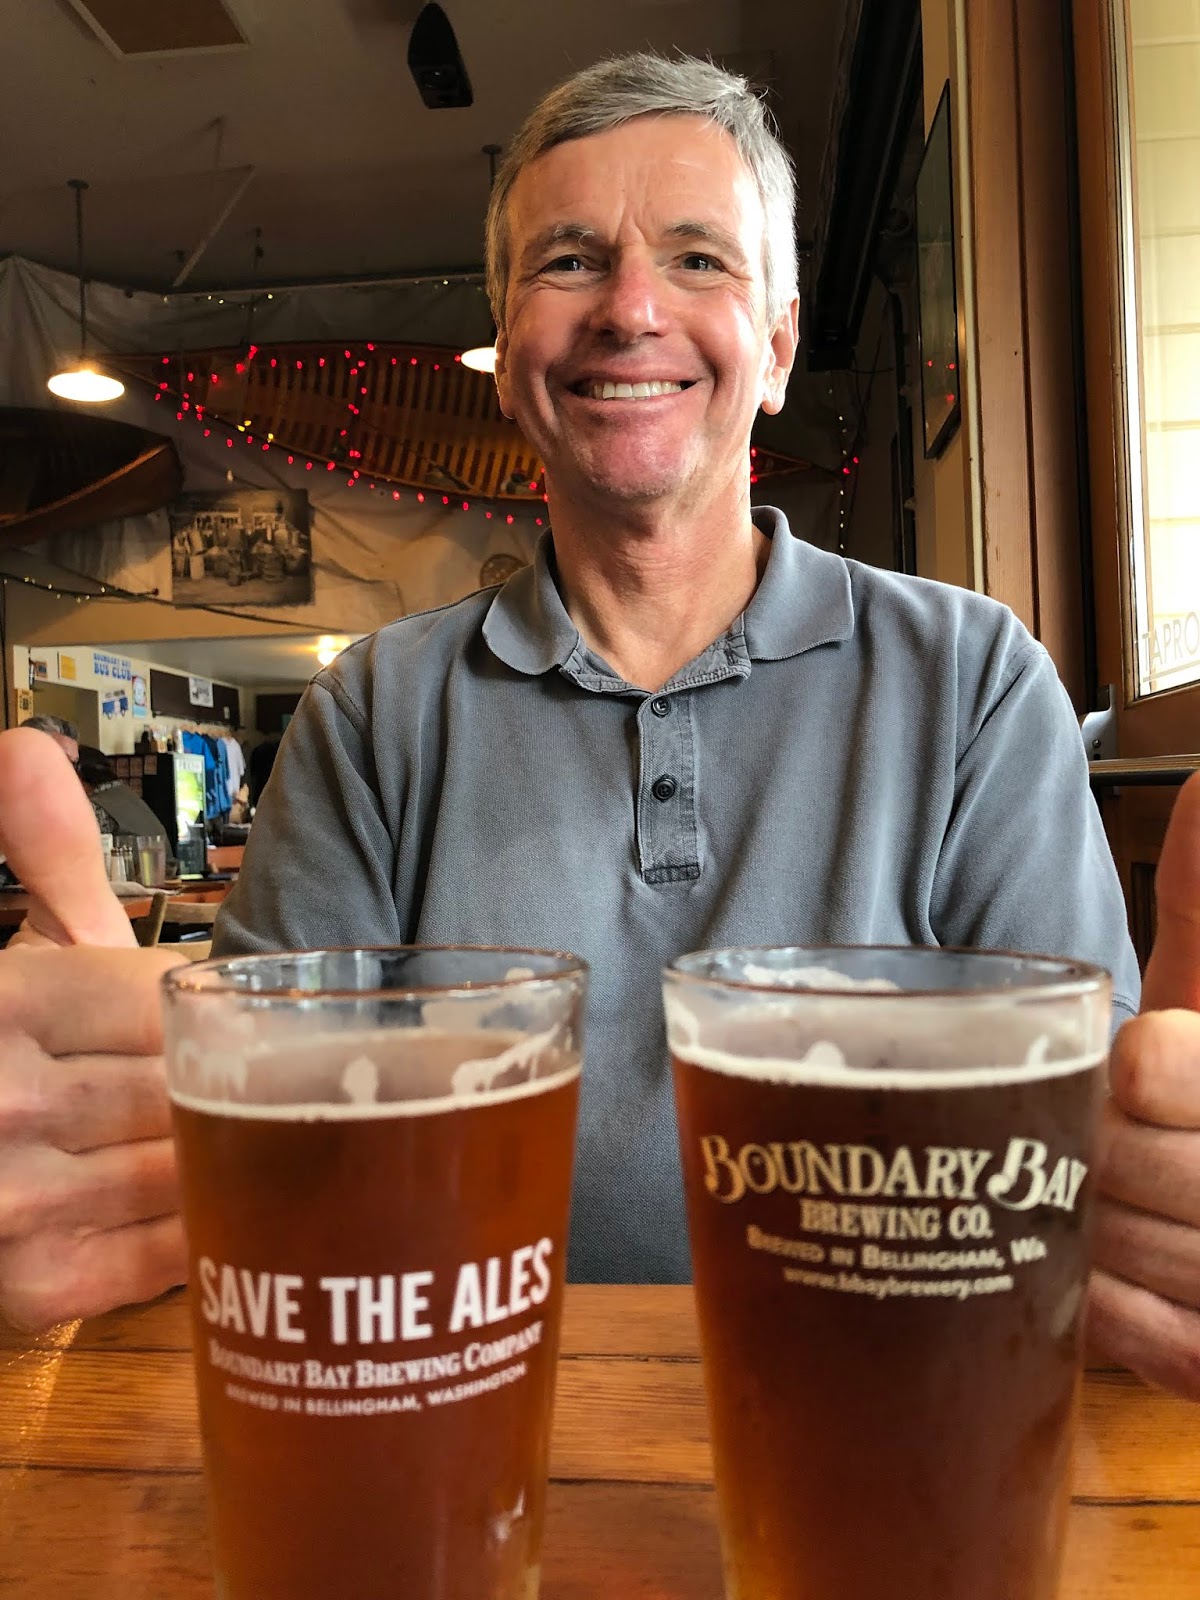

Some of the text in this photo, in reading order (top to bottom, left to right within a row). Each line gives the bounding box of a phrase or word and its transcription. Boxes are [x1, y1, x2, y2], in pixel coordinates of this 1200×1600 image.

[94, 663, 131, 681] BUS CLUB
[700, 1134, 1088, 1212] BOUNDARY BAY
[800, 1200, 995, 1241] BREWING CO.
[199, 1237, 553, 1345] SAVE THE ALES
[208, 1320, 545, 1390] BOUNDARY BAY BREWING COMPANY
[304, 1394, 423, 1417] BELLINGHAM,
[425, 1361, 528, 1407] WASHINGTON
